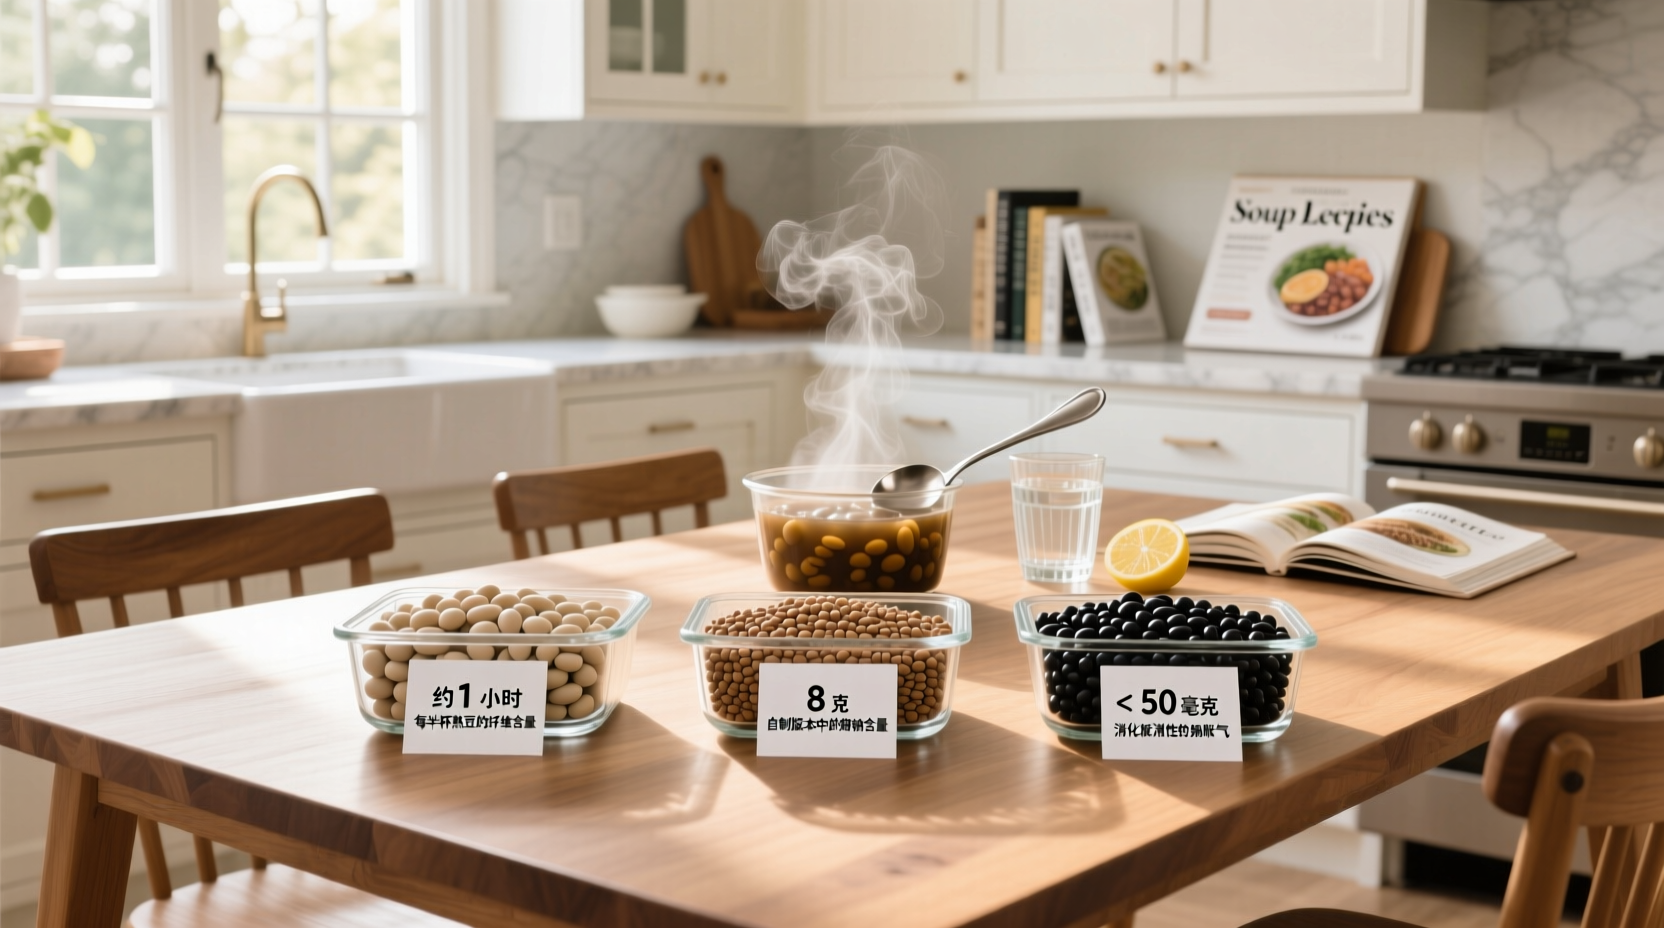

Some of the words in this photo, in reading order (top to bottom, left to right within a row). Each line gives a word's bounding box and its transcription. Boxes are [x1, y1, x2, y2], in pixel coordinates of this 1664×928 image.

[1230, 200, 1296, 232] Soup
[807, 685, 825, 712] 8
[831, 694, 849, 713] 克
